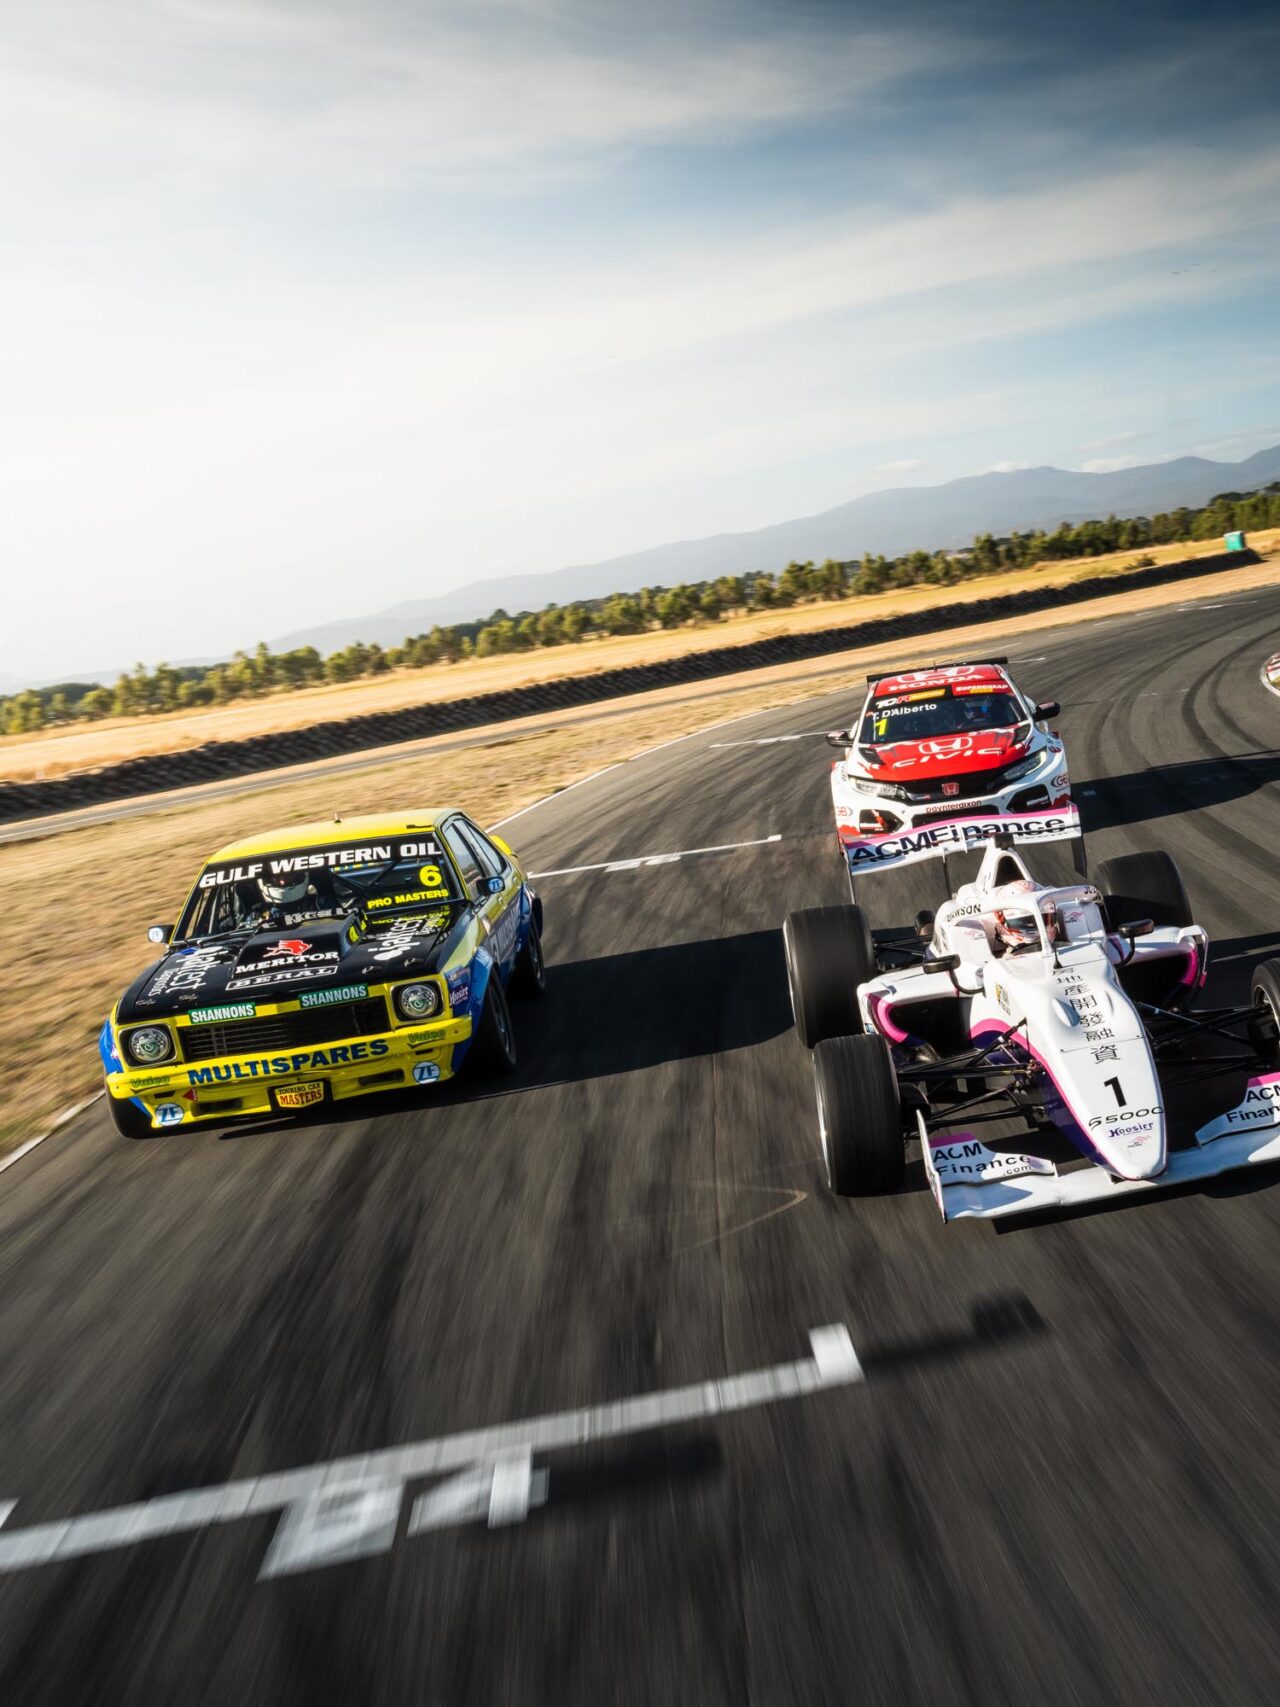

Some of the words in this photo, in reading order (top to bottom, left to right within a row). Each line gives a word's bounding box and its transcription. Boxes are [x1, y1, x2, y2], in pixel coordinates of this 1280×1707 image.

[888, 675, 985, 691] HONDA
[882, 704, 937, 718] D'Alberto
[874, 718, 888, 735] 1
[892, 747, 1002, 768] CIVIC
[199, 863, 263, 888] GULF
[270, 845, 391, 875] WESTERN
[400, 842, 442, 857] OIL
[419, 865, 443, 886] 6
[367, 897, 393, 909] PRO
[395, 889, 449, 904] MASTERS
[235, 951, 339, 974] MERITOR
[235, 968, 332, 988] BERAL
[301, 985, 367, 1008] SHANNONS
[191, 1004, 255, 1023] SHANNONS
[187, 1038, 389, 1086] MULTISPARES
[416, 1064, 438, 1081] ZF
[278, 1085, 306, 1094] TOURING
[308, 1083, 321, 1091] CAR
[280, 1090, 322, 1106] MASTERS
[1103, 1076, 1128, 1108] 1
[159, 1105, 181, 1123] ZF
[1088, 1106, 1164, 1131] S5000
[1108, 1122, 1154, 1138] Hoosier
[933, 1142, 982, 1162] ACM
[935, 1155, 1031, 1176] Finance
